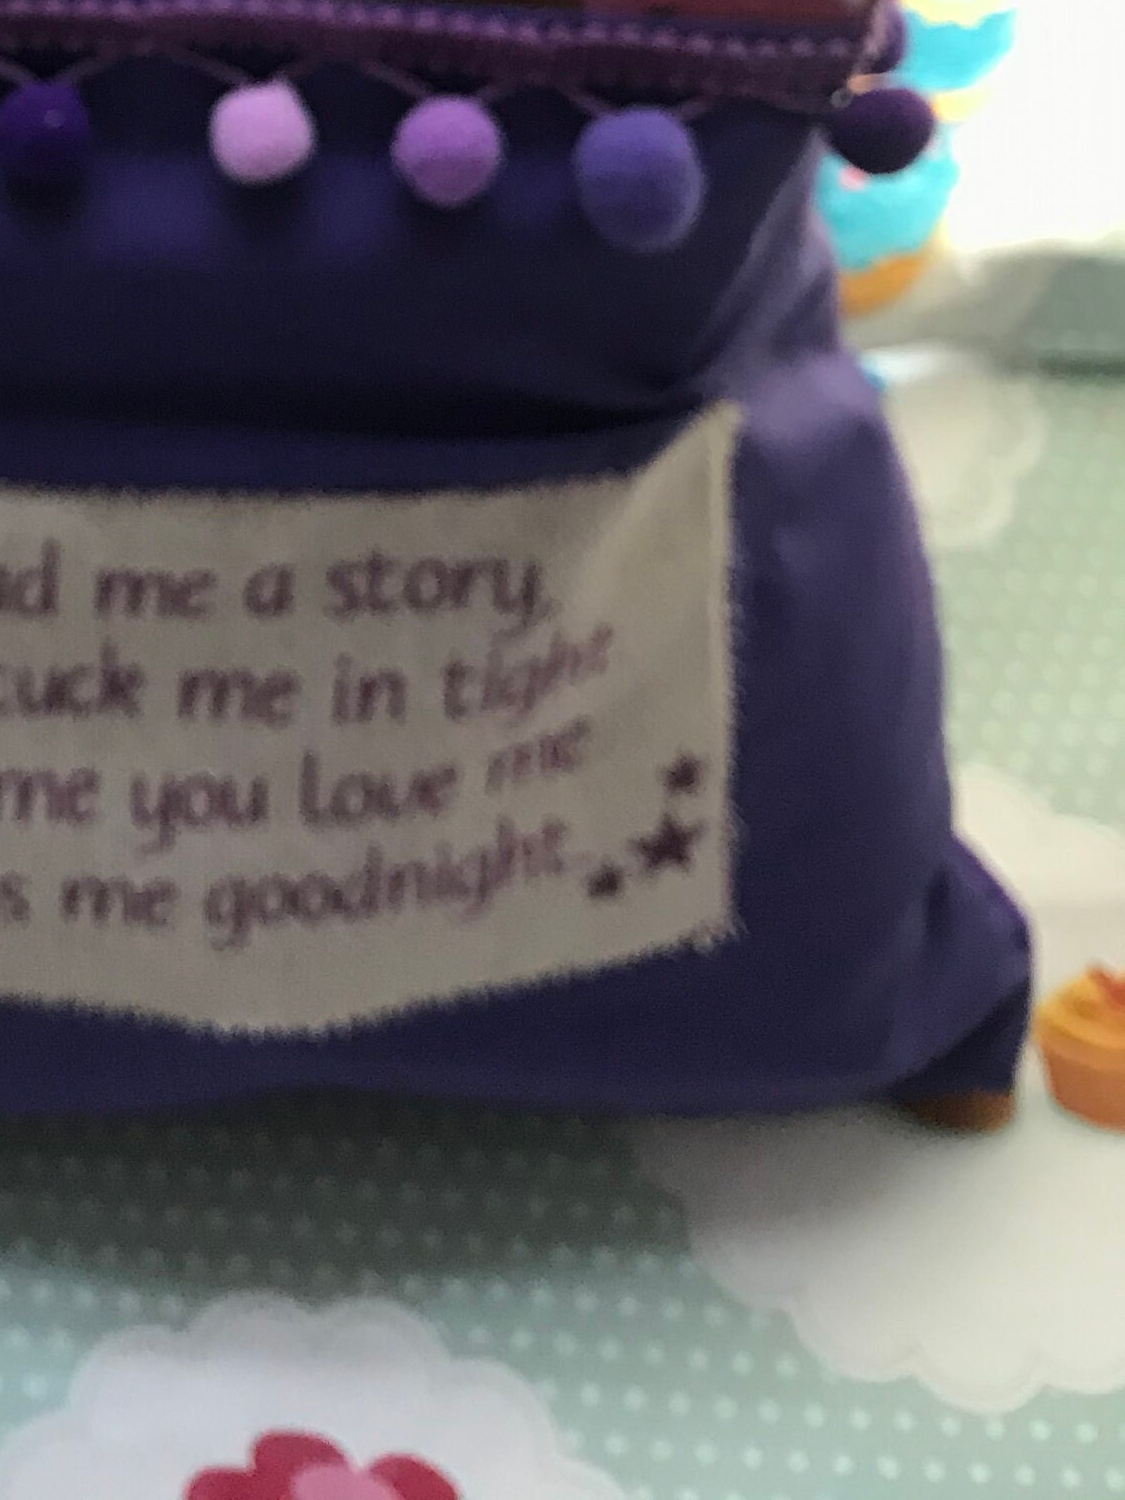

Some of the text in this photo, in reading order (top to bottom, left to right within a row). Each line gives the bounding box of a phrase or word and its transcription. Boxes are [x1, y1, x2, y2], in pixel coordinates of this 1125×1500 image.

[93, 568, 217, 619] me
[243, 563, 295, 618] a
[179, 668, 301, 726] me
[331, 653, 407, 724] in
[442, 620, 615, 725] tight
[130, 772, 269, 857] you
[299, 750, 458, 830] love
[61, 875, 179, 928] me
[203, 817, 567, 952] goodnight
